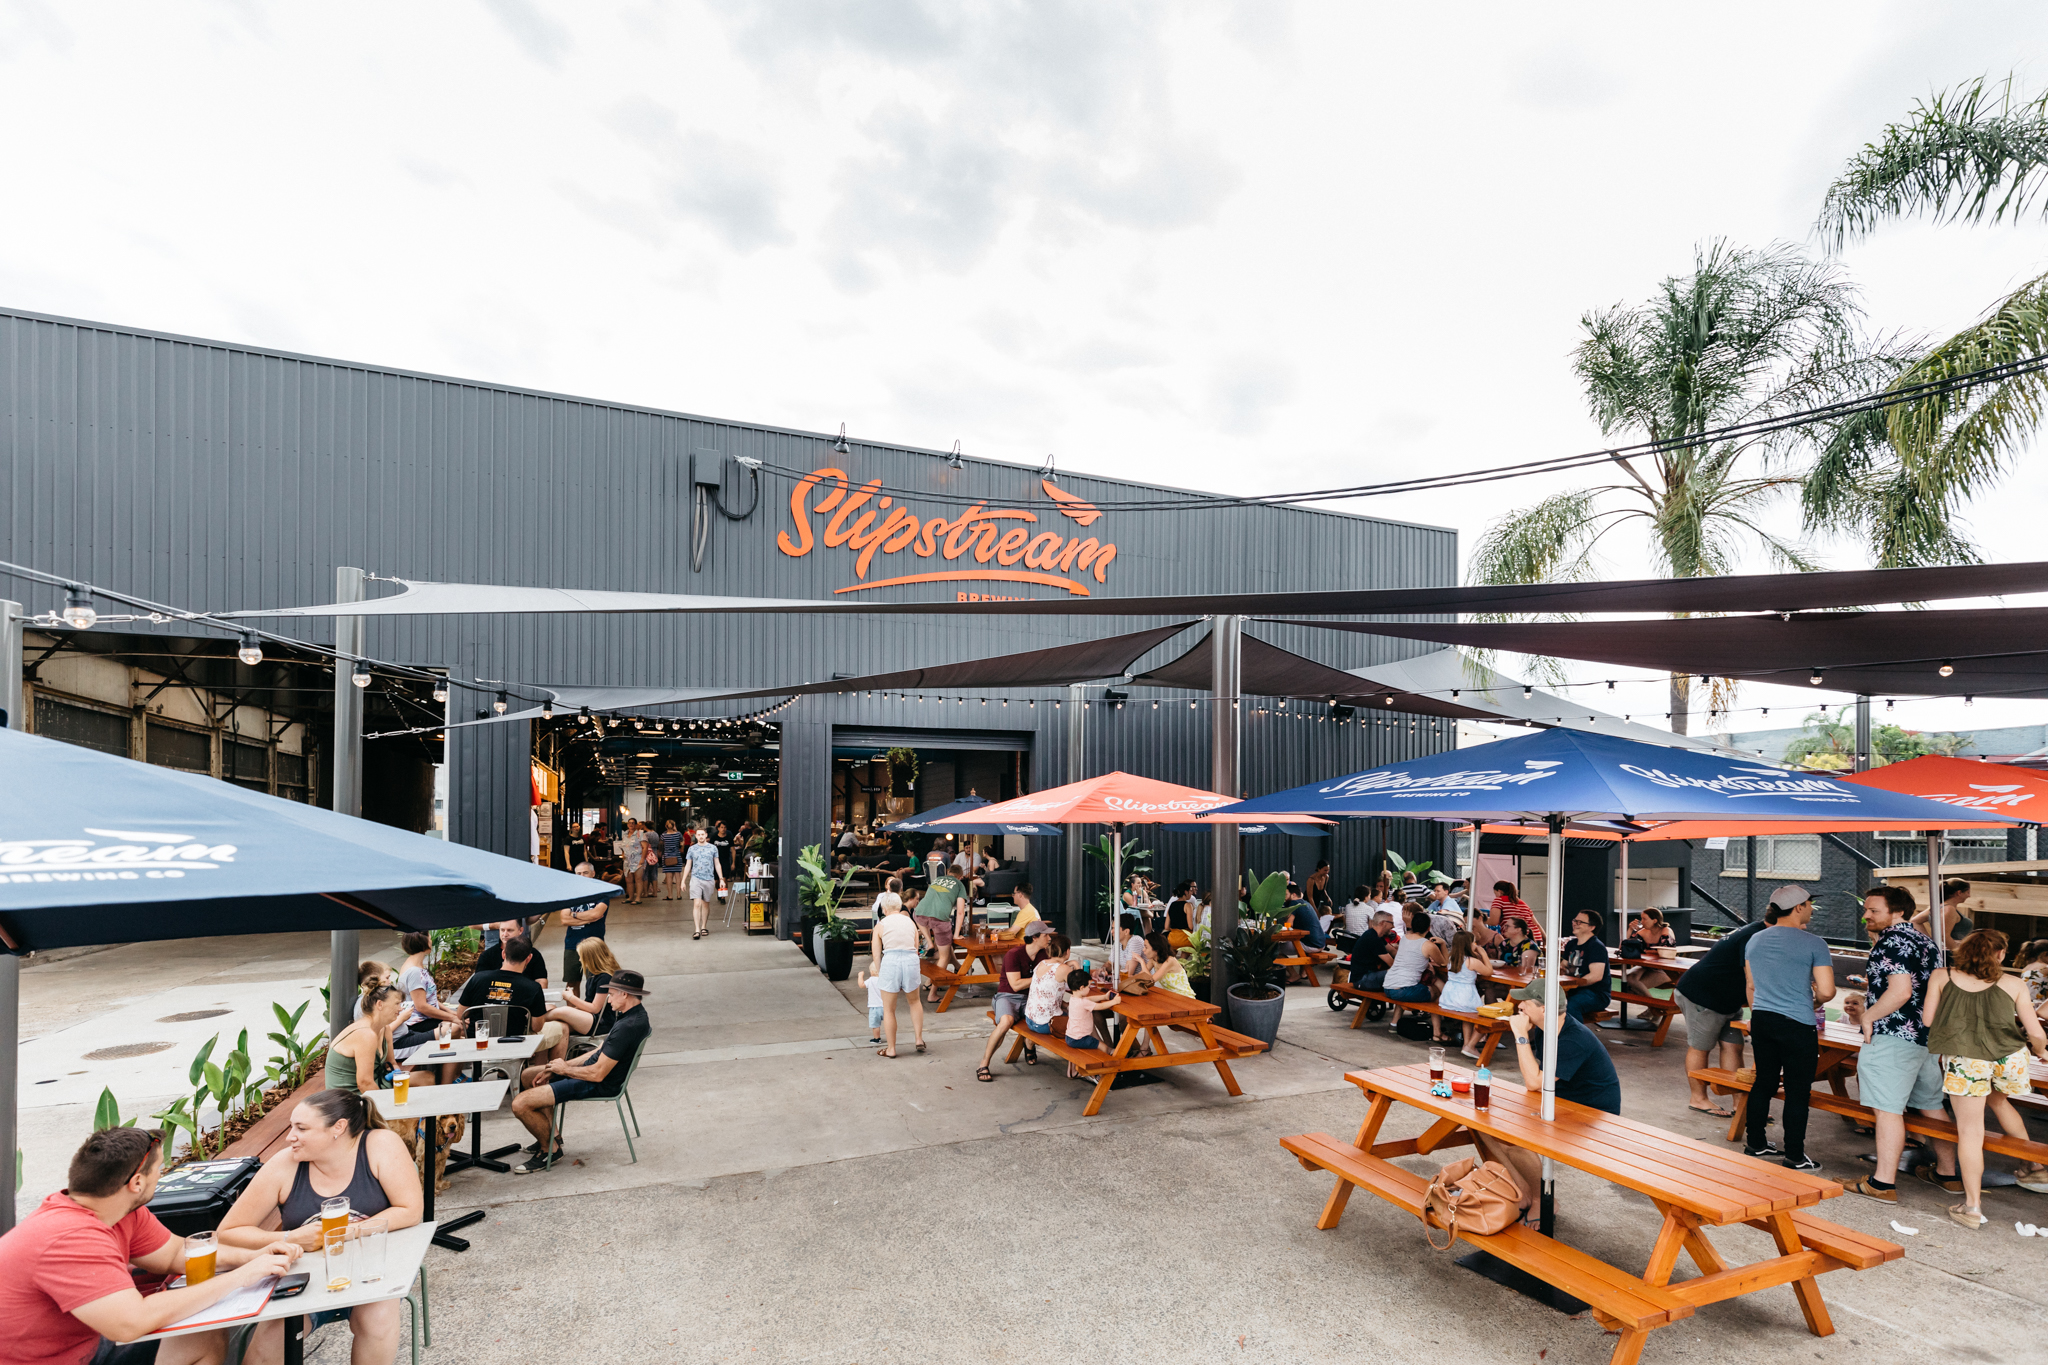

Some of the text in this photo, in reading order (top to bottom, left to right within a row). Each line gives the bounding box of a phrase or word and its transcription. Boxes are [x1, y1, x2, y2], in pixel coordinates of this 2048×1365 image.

[777, 468, 1117, 583] Slipstream
[1319, 770, 1557, 796] Slipstream
[1619, 763, 1853, 795] Slipstream
[145, 869, 186, 879] CO
